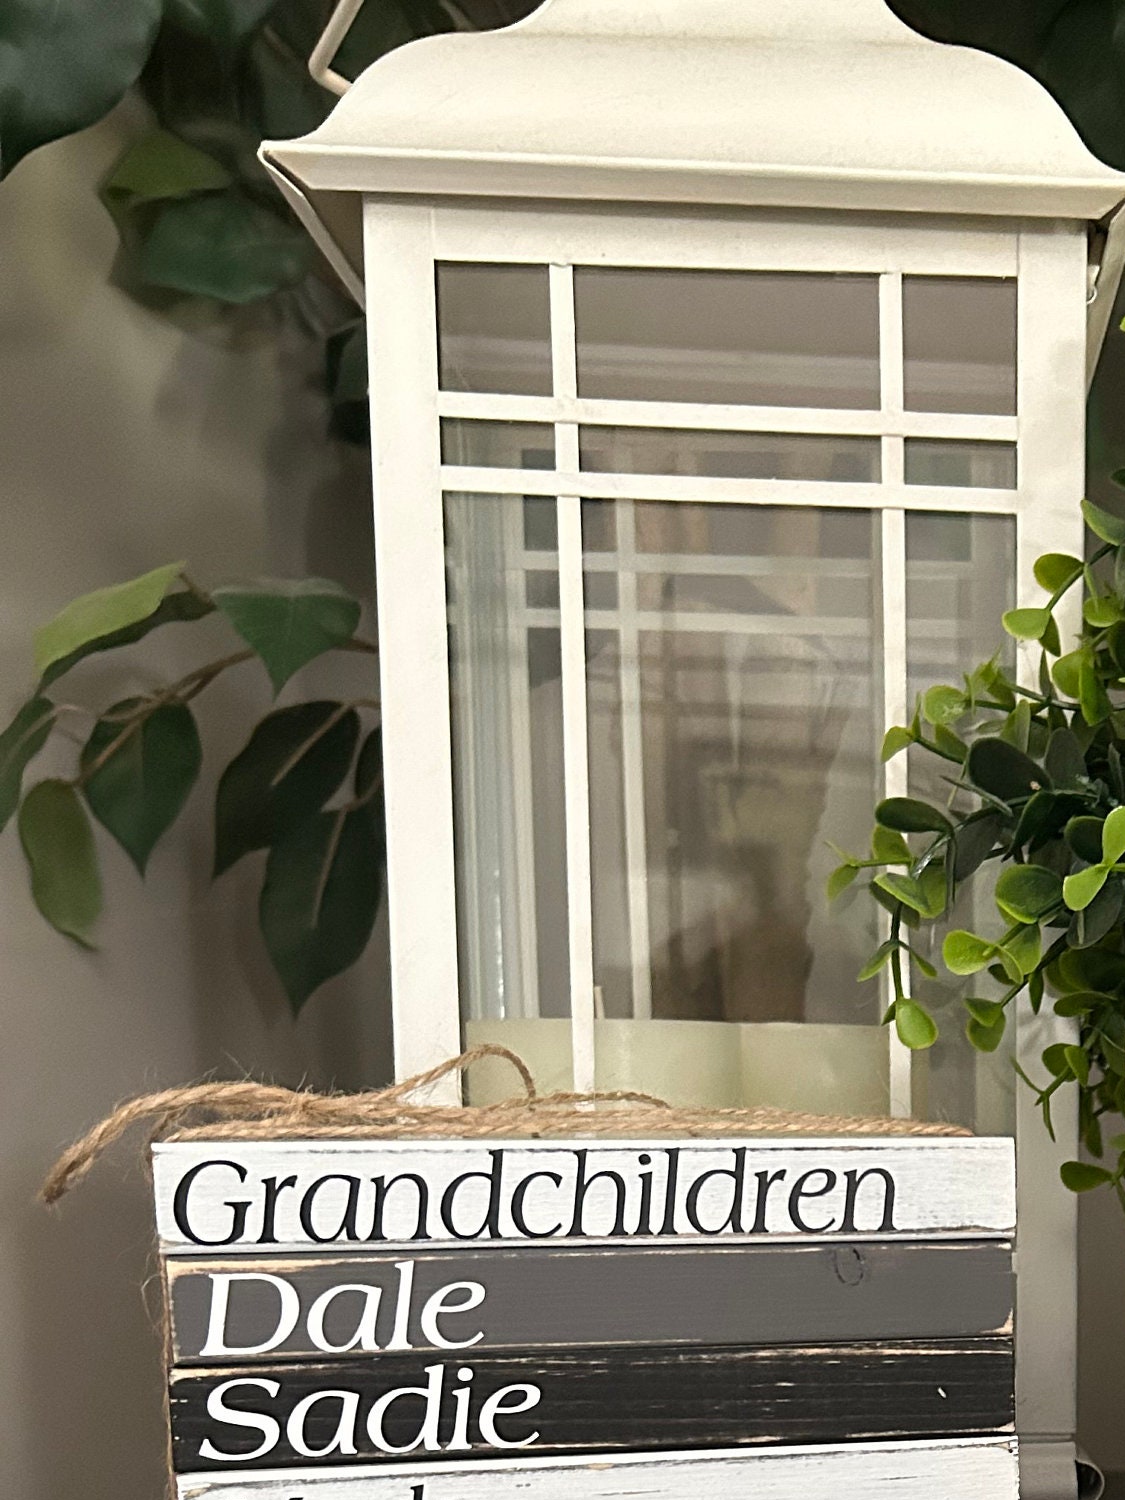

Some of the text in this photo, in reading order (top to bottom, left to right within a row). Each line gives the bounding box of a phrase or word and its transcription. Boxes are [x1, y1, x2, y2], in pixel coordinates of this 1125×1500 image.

[174, 1148, 896, 1246] Grandchildren
[200, 1262, 485, 1357] Dale
[200, 1365, 541, 1461] Sadie
